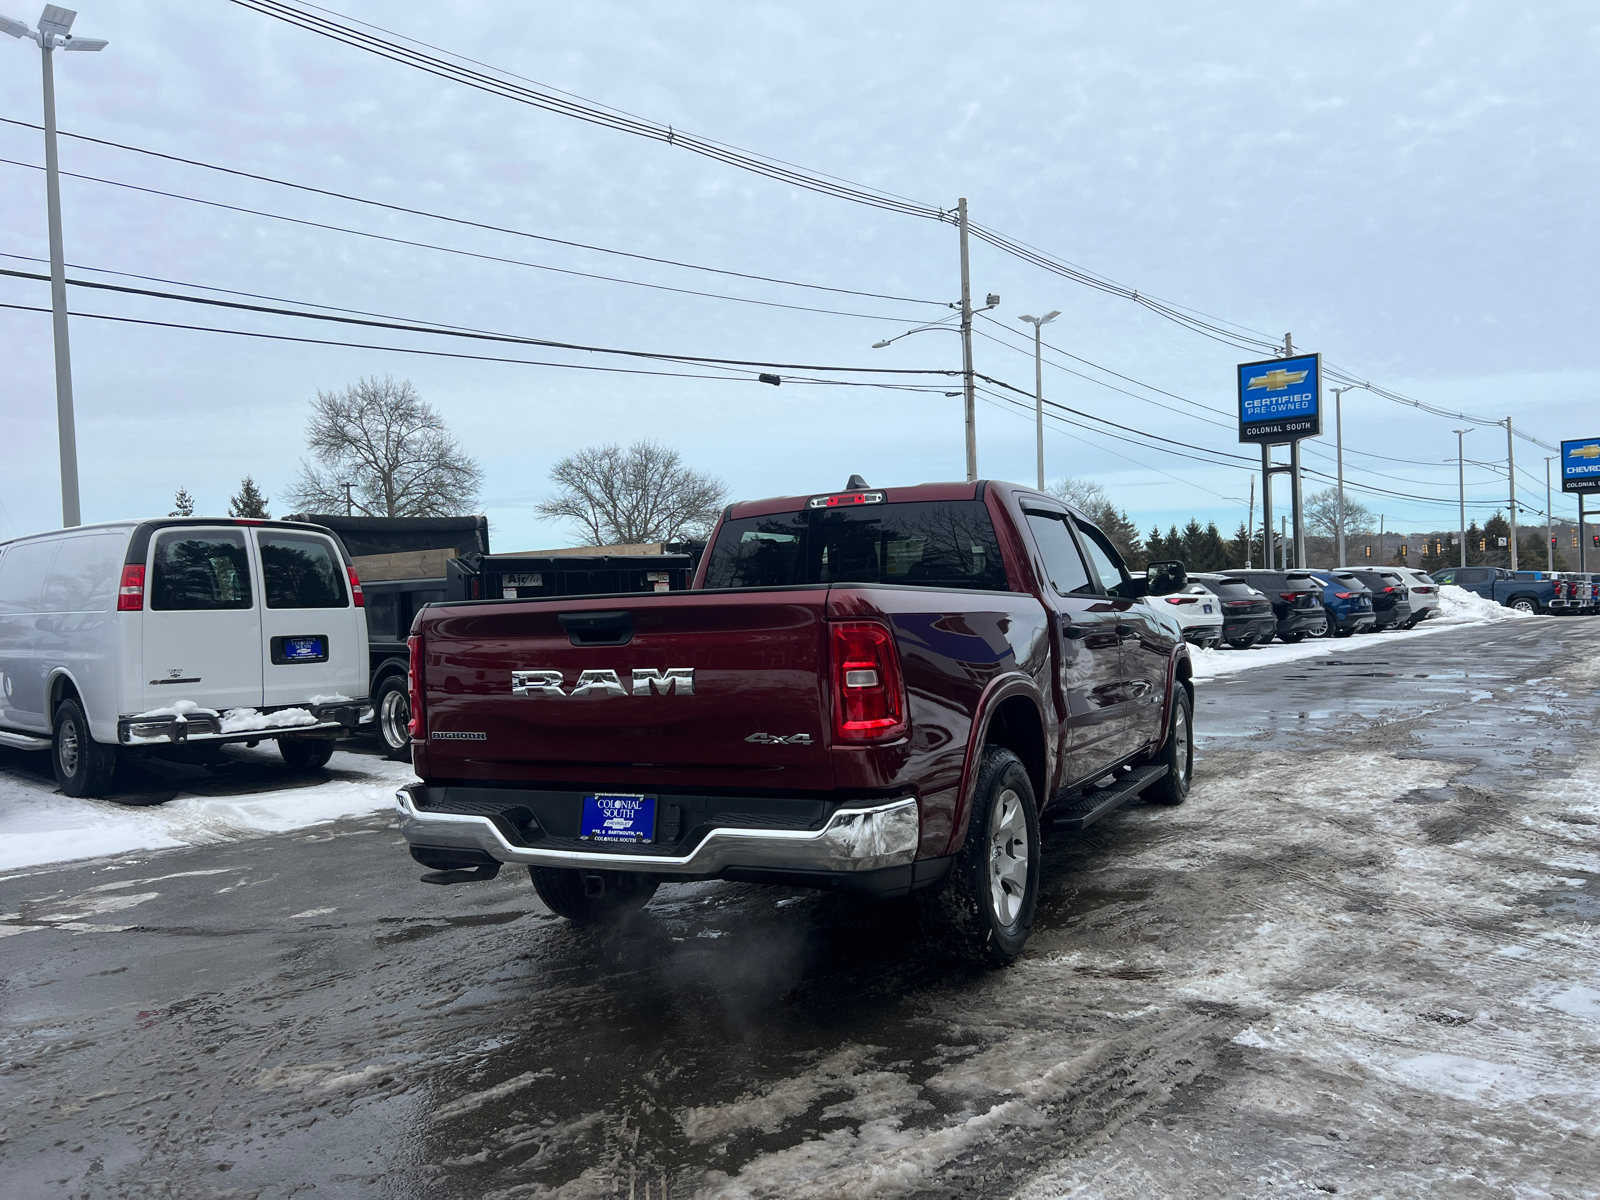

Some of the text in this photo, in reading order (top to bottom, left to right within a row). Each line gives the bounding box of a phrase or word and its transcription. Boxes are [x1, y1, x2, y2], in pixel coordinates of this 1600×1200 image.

[1244, 393, 1312, 408] CERTIFIED
[1247, 401, 1309, 415] PRE-OWNED
[1246, 422, 1311, 435] COLONIAL SOUTH
[507, 574, 539, 585] Airflo
[511, 667, 697, 697] RAM
[431, 731, 487, 741] BIGHORN
[743, 732, 816, 746] 4x4
[597, 799, 643, 810] COLONIAL
[603, 808, 635, 818] SOUTH
